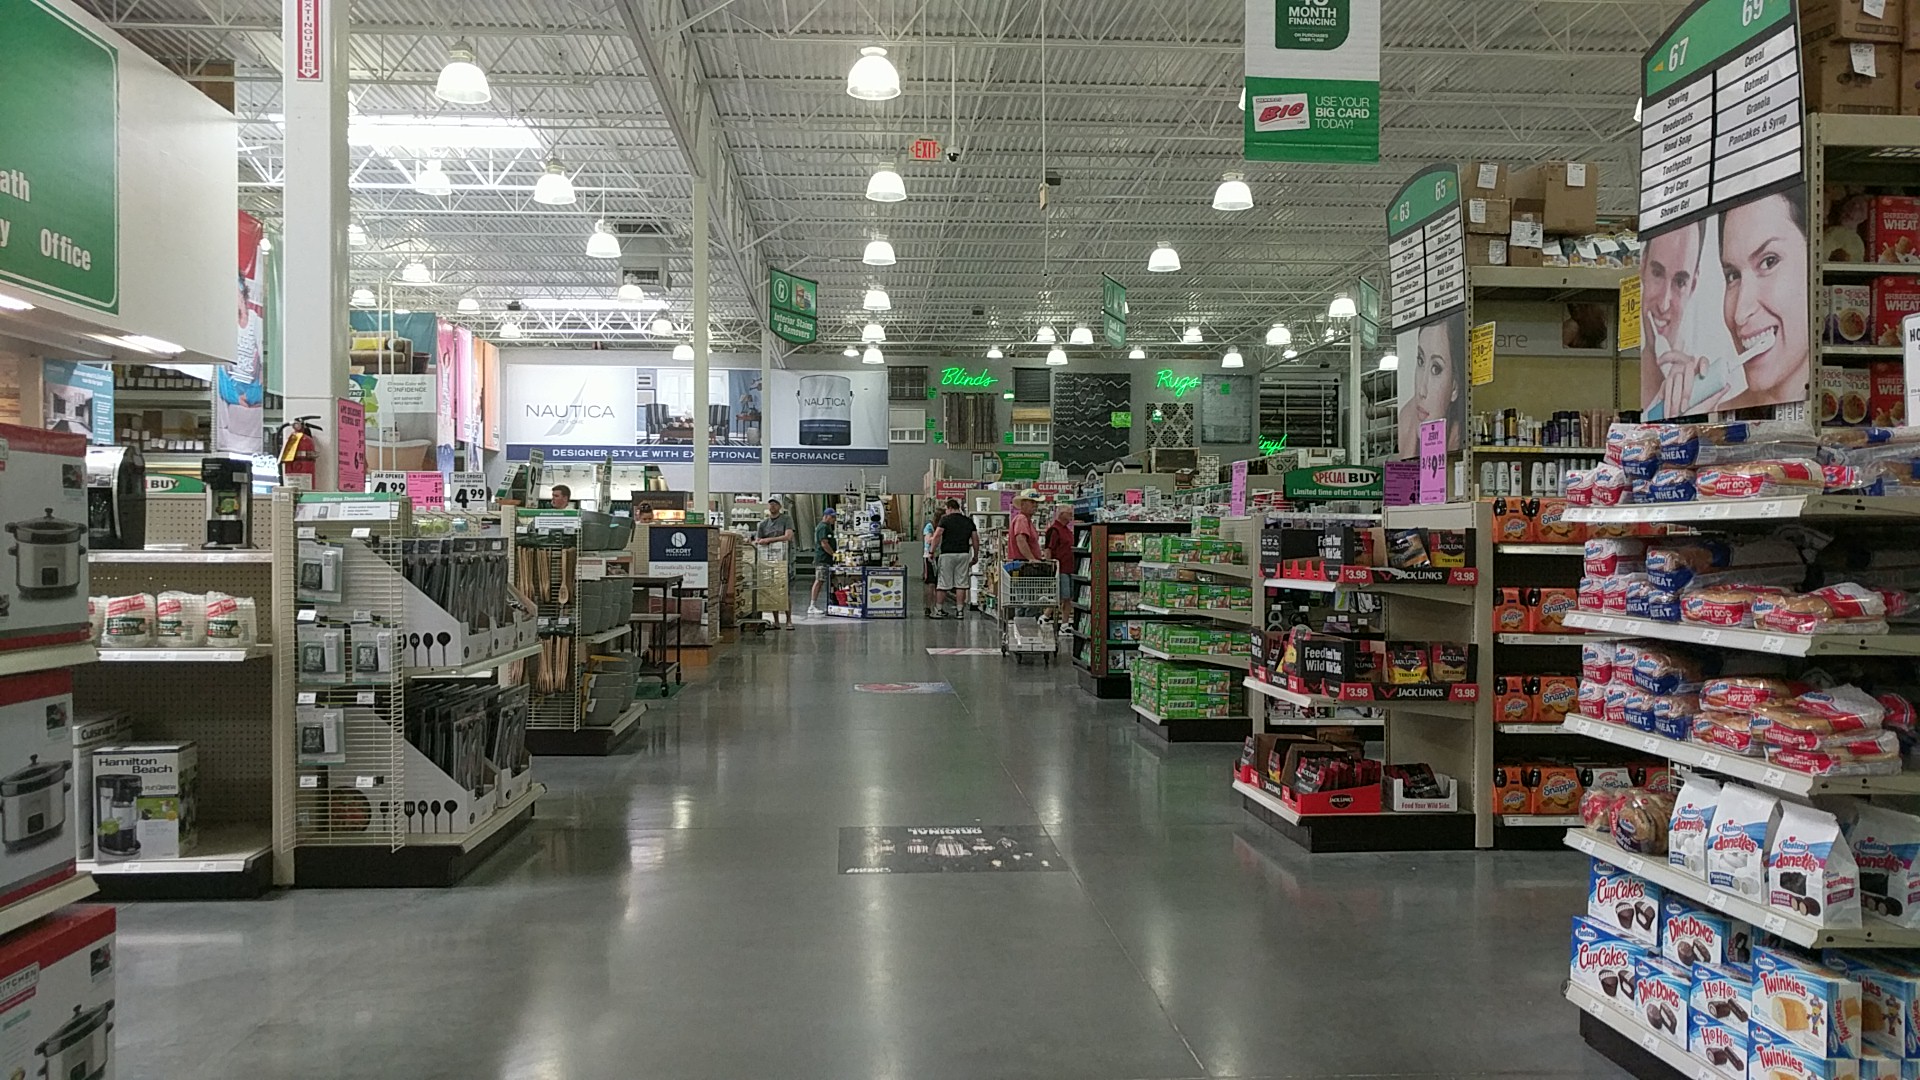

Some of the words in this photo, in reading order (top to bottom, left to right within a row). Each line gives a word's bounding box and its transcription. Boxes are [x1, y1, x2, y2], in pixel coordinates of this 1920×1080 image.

[1288, 7, 1337, 18] MONTH
[1742, 0, 1764, 26] 69
[1288, 18, 1336, 26] FINANCING
[304, 0, 313, 74] XTINGUISHER
[1668, 37, 1689, 72] 67
[1744, 48, 1764, 68] Cereal
[1744, 70, 1770, 92] Oatmeal
[1315, 96, 1337, 106] USE
[1338, 97, 1370, 107] YOUR
[1668, 90, 1689, 109] Shaving
[1746, 96, 1770, 115] Granola
[1315, 108, 1334, 117] BIG
[1337, 108, 1369, 118] CARD
[1315, 118, 1353, 129] TODAY!
[1662, 112, 1693, 134] Deodorants
[1728, 124, 1760, 146] Pancakes
[1762, 121, 1768, 132] &
[1768, 114, 1787, 130] Syrup
[915, 141, 937, 158] EXIT
[1663, 139, 1677, 153] Hand
[1678, 134, 1692, 148] Soap
[1662, 156, 1692, 176] Toothpaste
[1435, 178, 1446, 200] 65
[1664, 183, 1675, 197] Oral
[1676, 179, 1688, 192] Care
[1400, 201, 1410, 222] 63
[1660, 203, 1680, 218] Shower
[1681, 199, 1690, 211] Gel
[1884, 219, 1919, 231] WHEAT
[40, 228, 91, 272] Office
[1844, 290, 1870, 300] grape
[774, 312, 795, 325] Interior
[796, 318, 813, 330] Stains
[783, 325, 810, 338] Removers
[942, 368, 998, 387] Blinds
[1156, 369, 1201, 397] Rugs
[804, 397, 846, 407] NAUTICA
[526, 404, 615, 418] NAUTICA
[1259, 434, 1287, 456] inyl
[552, 449, 608, 457] DESIGNER
[683, 451, 759, 459] EXEPTIONAL
[770, 452, 845, 460] ERFORMANCE
[151, 480, 178, 489] BUY
[1314, 472, 1346, 483] SPECIAL
[1348, 473, 1380, 483] BUY
[1655, 490, 1685, 499] WHEAT
[1346, 569, 1367, 579] $3.98
[1454, 571, 1475, 581] $3.98
[1586, 564, 1606, 572] WHITE
[1542, 599, 1576, 614] Snapple
[1306, 660, 1325, 671] Wild
[1616, 672, 1634, 682] WHIT
[1635, 678, 1659, 691] WHEAT
[1347, 686, 1368, 697] $3.98
[1397, 688, 1418, 697] JACK
[1455, 688, 1475, 697] $3.98
[1543, 688, 1576, 704] Snapple
[1609, 711, 1626, 720] WHIT
[1626, 714, 1647, 725] WHEAT
[99, 758, 157, 766] Hamilton
[132, 765, 173, 774] Beach
[1543, 781, 1577, 796] Snapple
[1722, 823, 1742, 832] Hostess
[1714, 833, 1757, 852] donettes
[1781, 841, 1807, 851] Hostess
[1776, 853, 1818, 871] donettes
[1597, 878, 1645, 902] CupCakes
[1579, 944, 1628, 969] CupCakes
[1760, 972, 1806, 997] Twinkies
[1756, 1045, 1803, 1073] Twinkies
